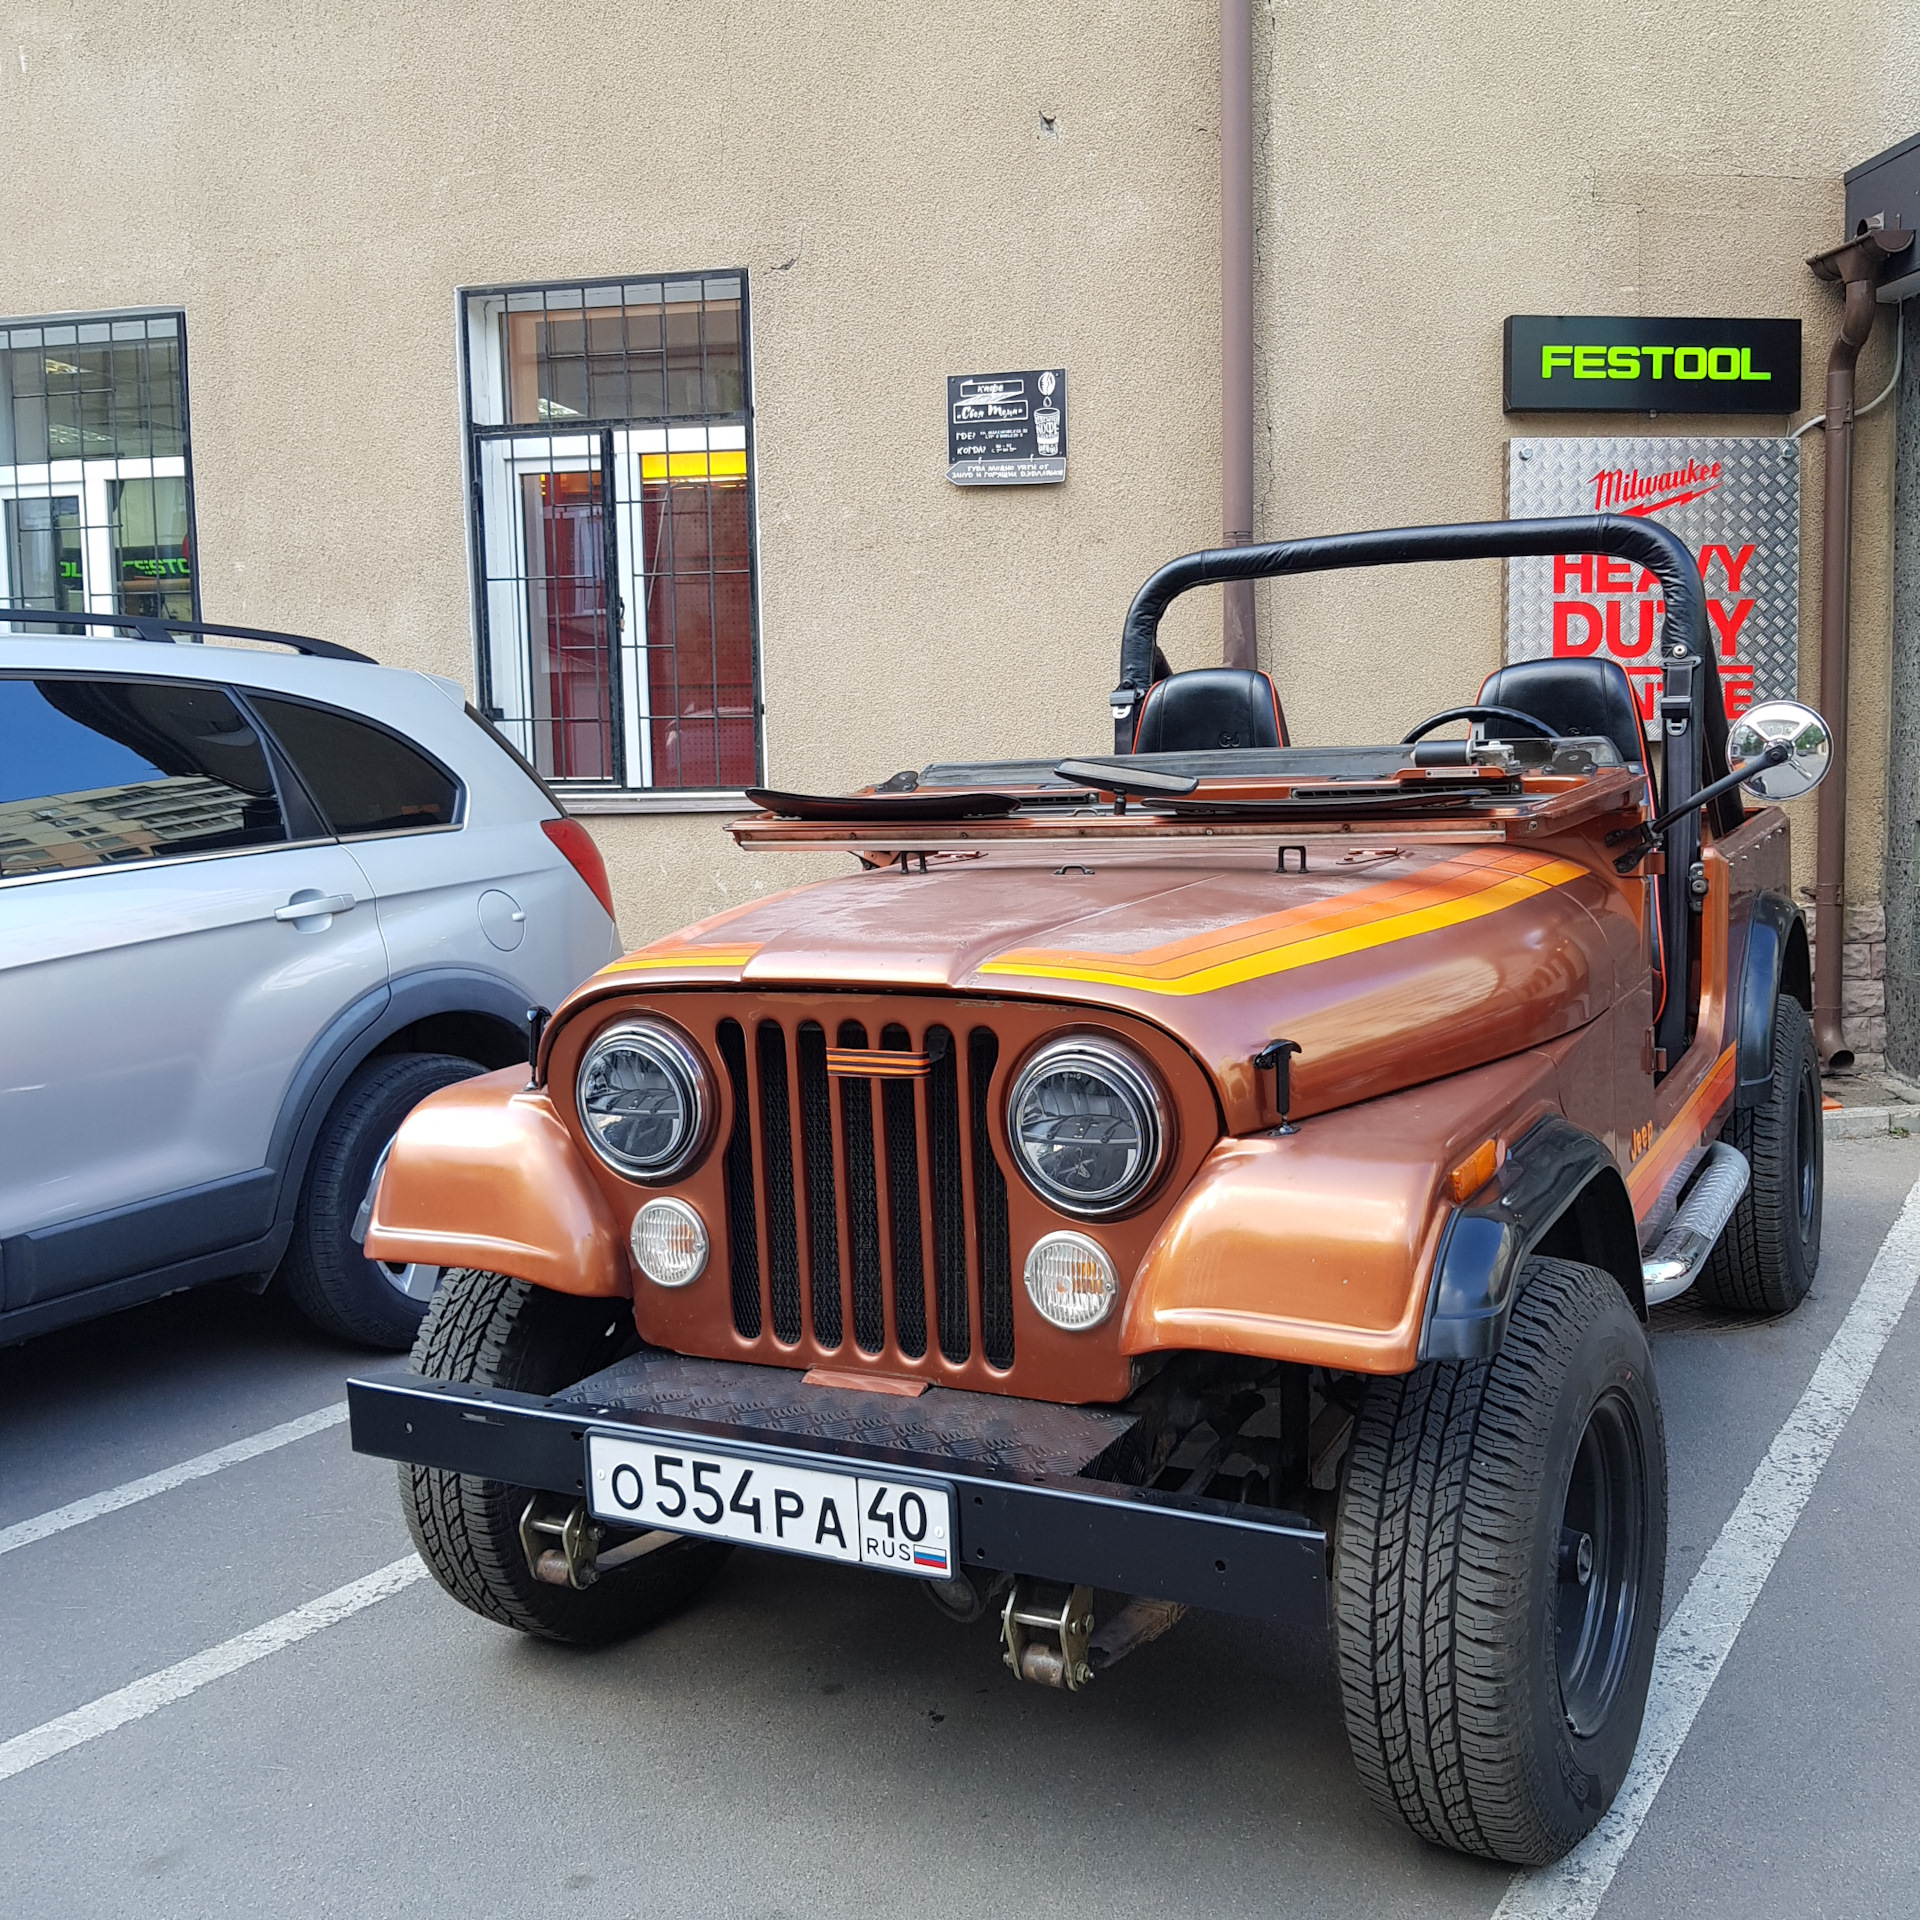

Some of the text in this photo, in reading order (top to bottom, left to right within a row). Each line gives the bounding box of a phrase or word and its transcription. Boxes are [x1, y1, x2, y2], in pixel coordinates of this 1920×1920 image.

[1541, 345, 1772, 381] FESTOOL
[1587, 458, 1724, 511] Milwaukee
[1553, 599, 1756, 658] DUY
[1631, 1120, 1653, 1162] Jeep
[867, 1487, 928, 1542] 40
[866, 1537, 911, 1561] RUS
